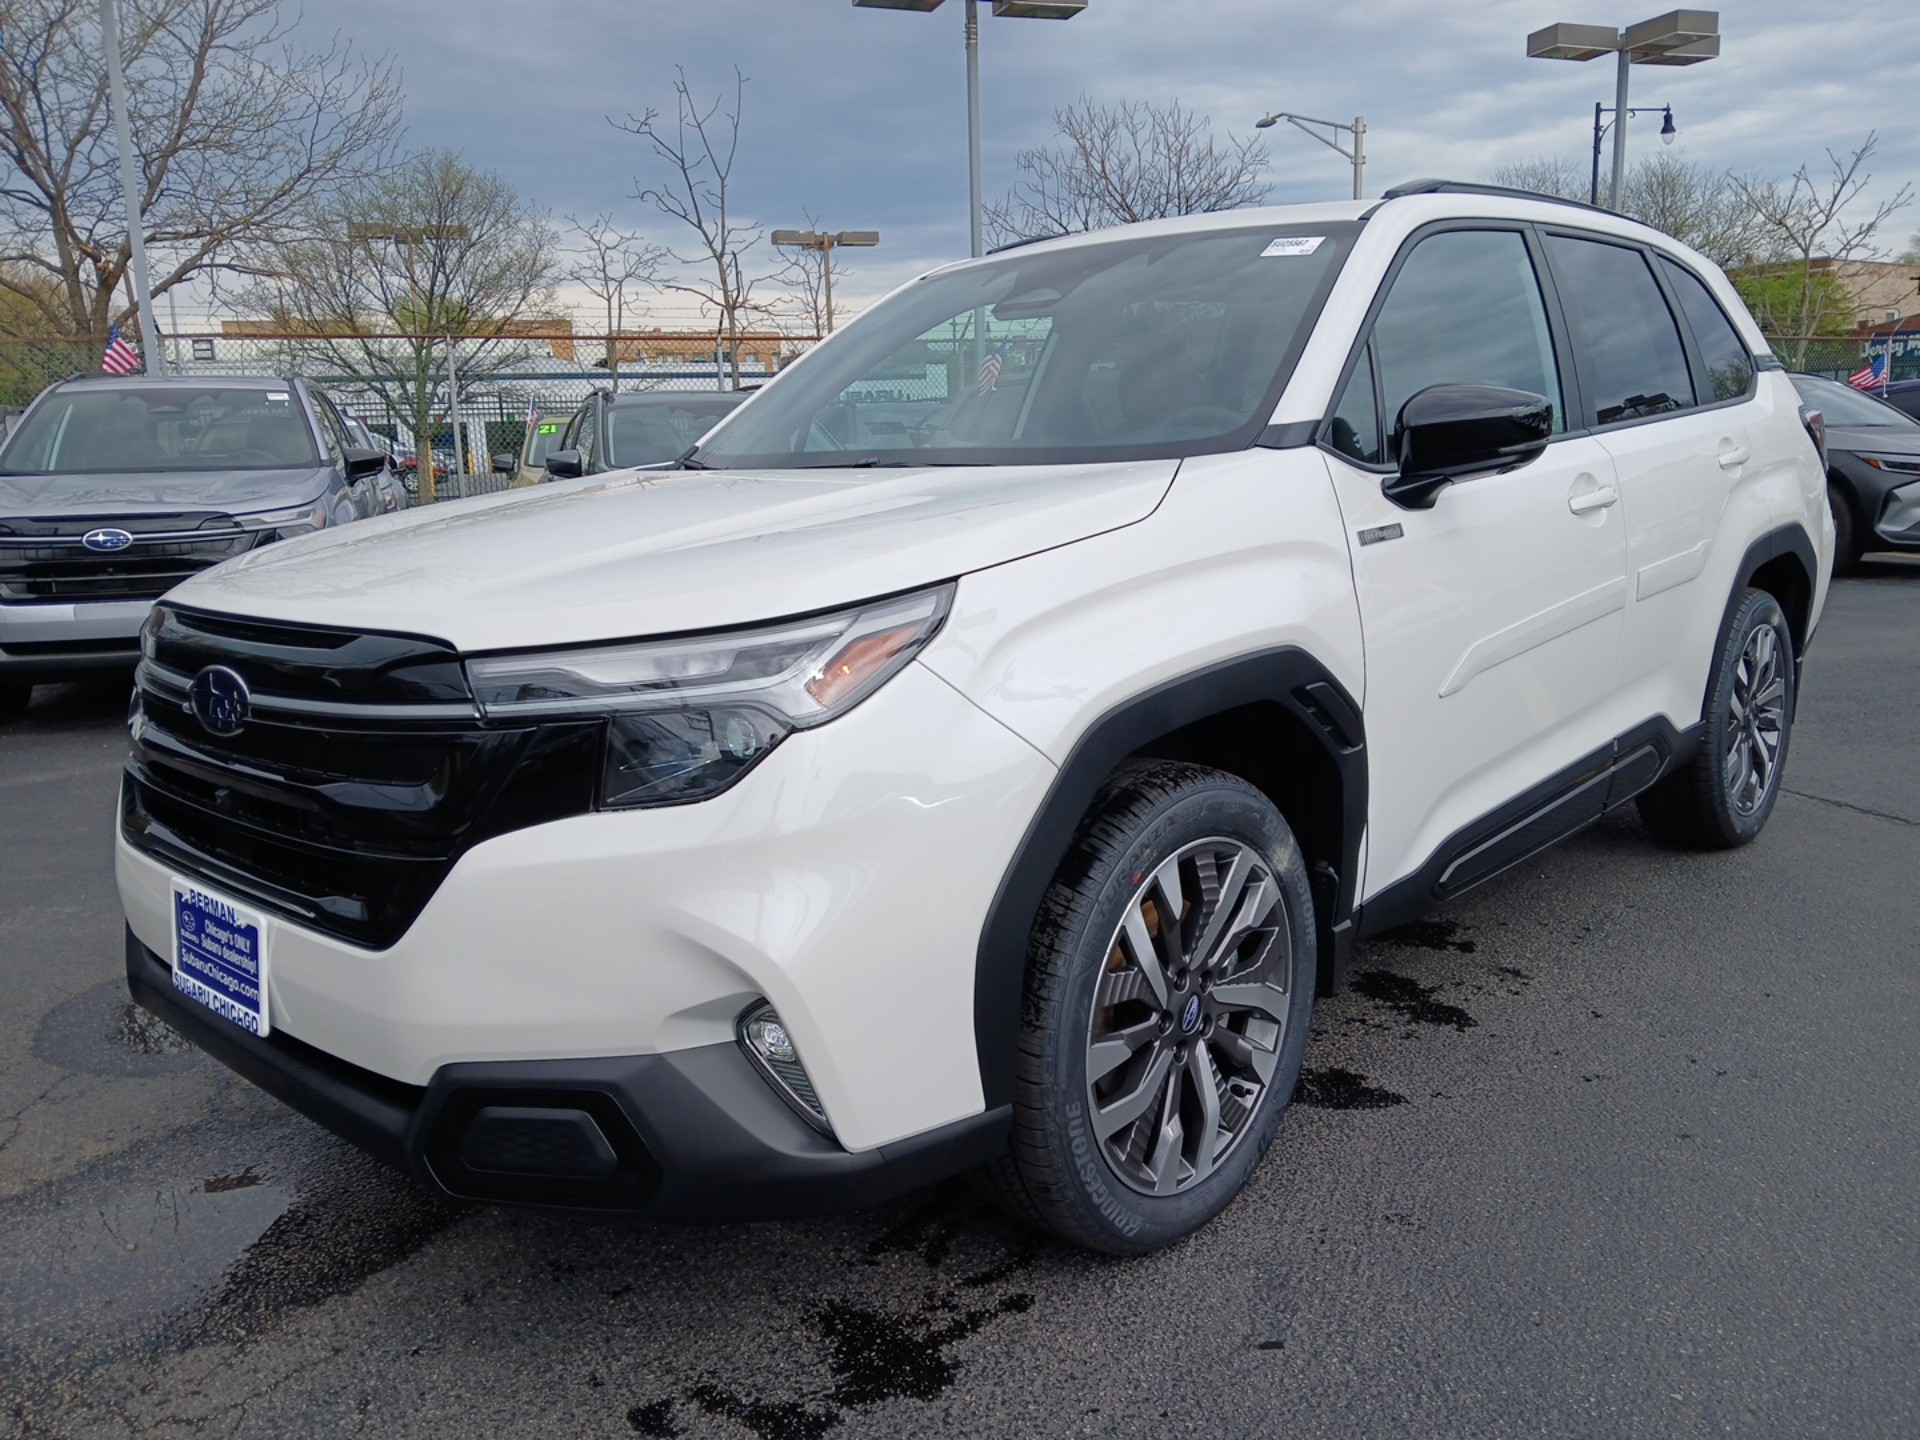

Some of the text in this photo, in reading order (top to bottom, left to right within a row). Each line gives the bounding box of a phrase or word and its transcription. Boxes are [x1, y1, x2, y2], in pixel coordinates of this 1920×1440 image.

[539, 424, 558, 435] 21
[1262, 815, 1316, 947] BRGESTONE
[190, 889, 236, 925] BERMAN
[200, 933, 222, 956] Subaru
[204, 919, 251, 954] Chicago's ONLY
[181, 948, 259, 1002] SubaruChicago.com
[174, 972, 259, 1034] SUBARU CHICAGO
[1065, 1101, 1143, 1238] BRIDGESTONE
